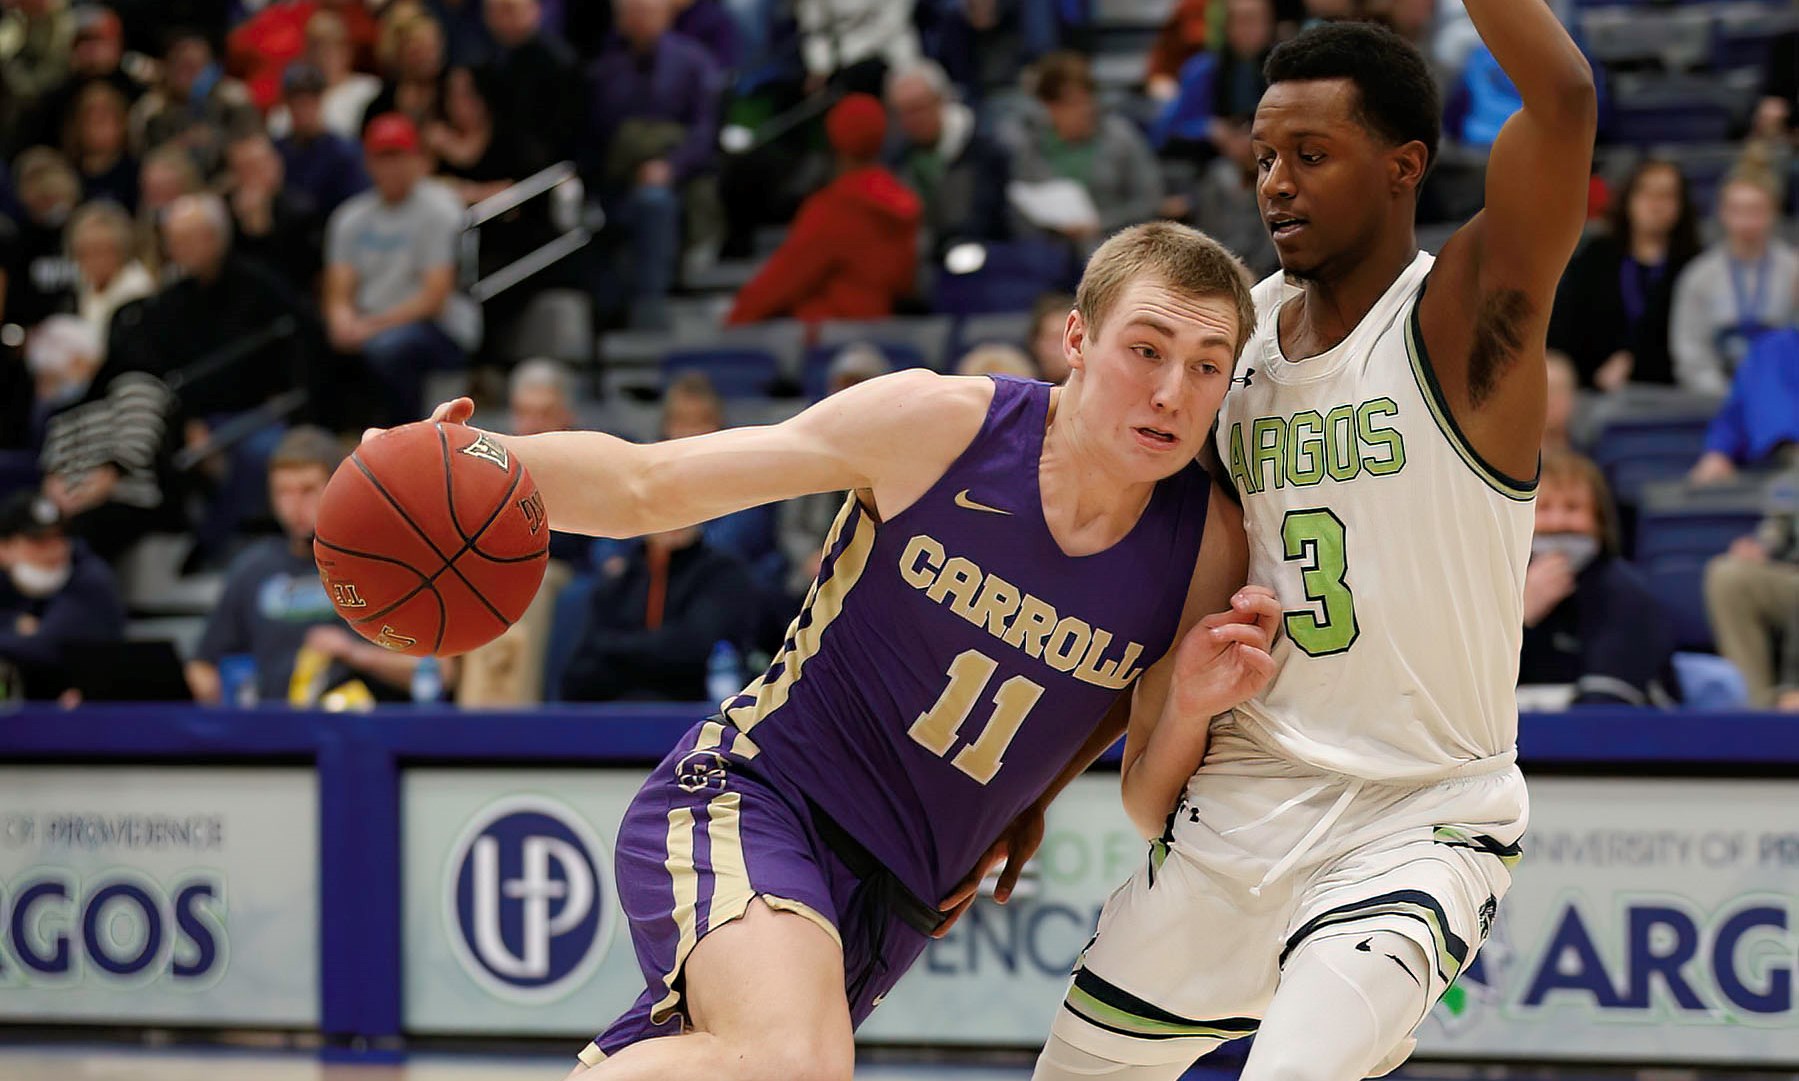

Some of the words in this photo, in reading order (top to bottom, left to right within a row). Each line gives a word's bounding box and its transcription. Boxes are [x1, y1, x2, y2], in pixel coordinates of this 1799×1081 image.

[1230, 396, 1407, 494] ARGOS
[898, 534, 1145, 690] CARROLL
[1280, 506, 1361, 658] 3
[906, 648, 1046, 786] 11
[49, 815, 223, 845] PROVIDENCE
[1526, 831, 1693, 866] NIVERSITY
[0, 882, 216, 977] GOS
